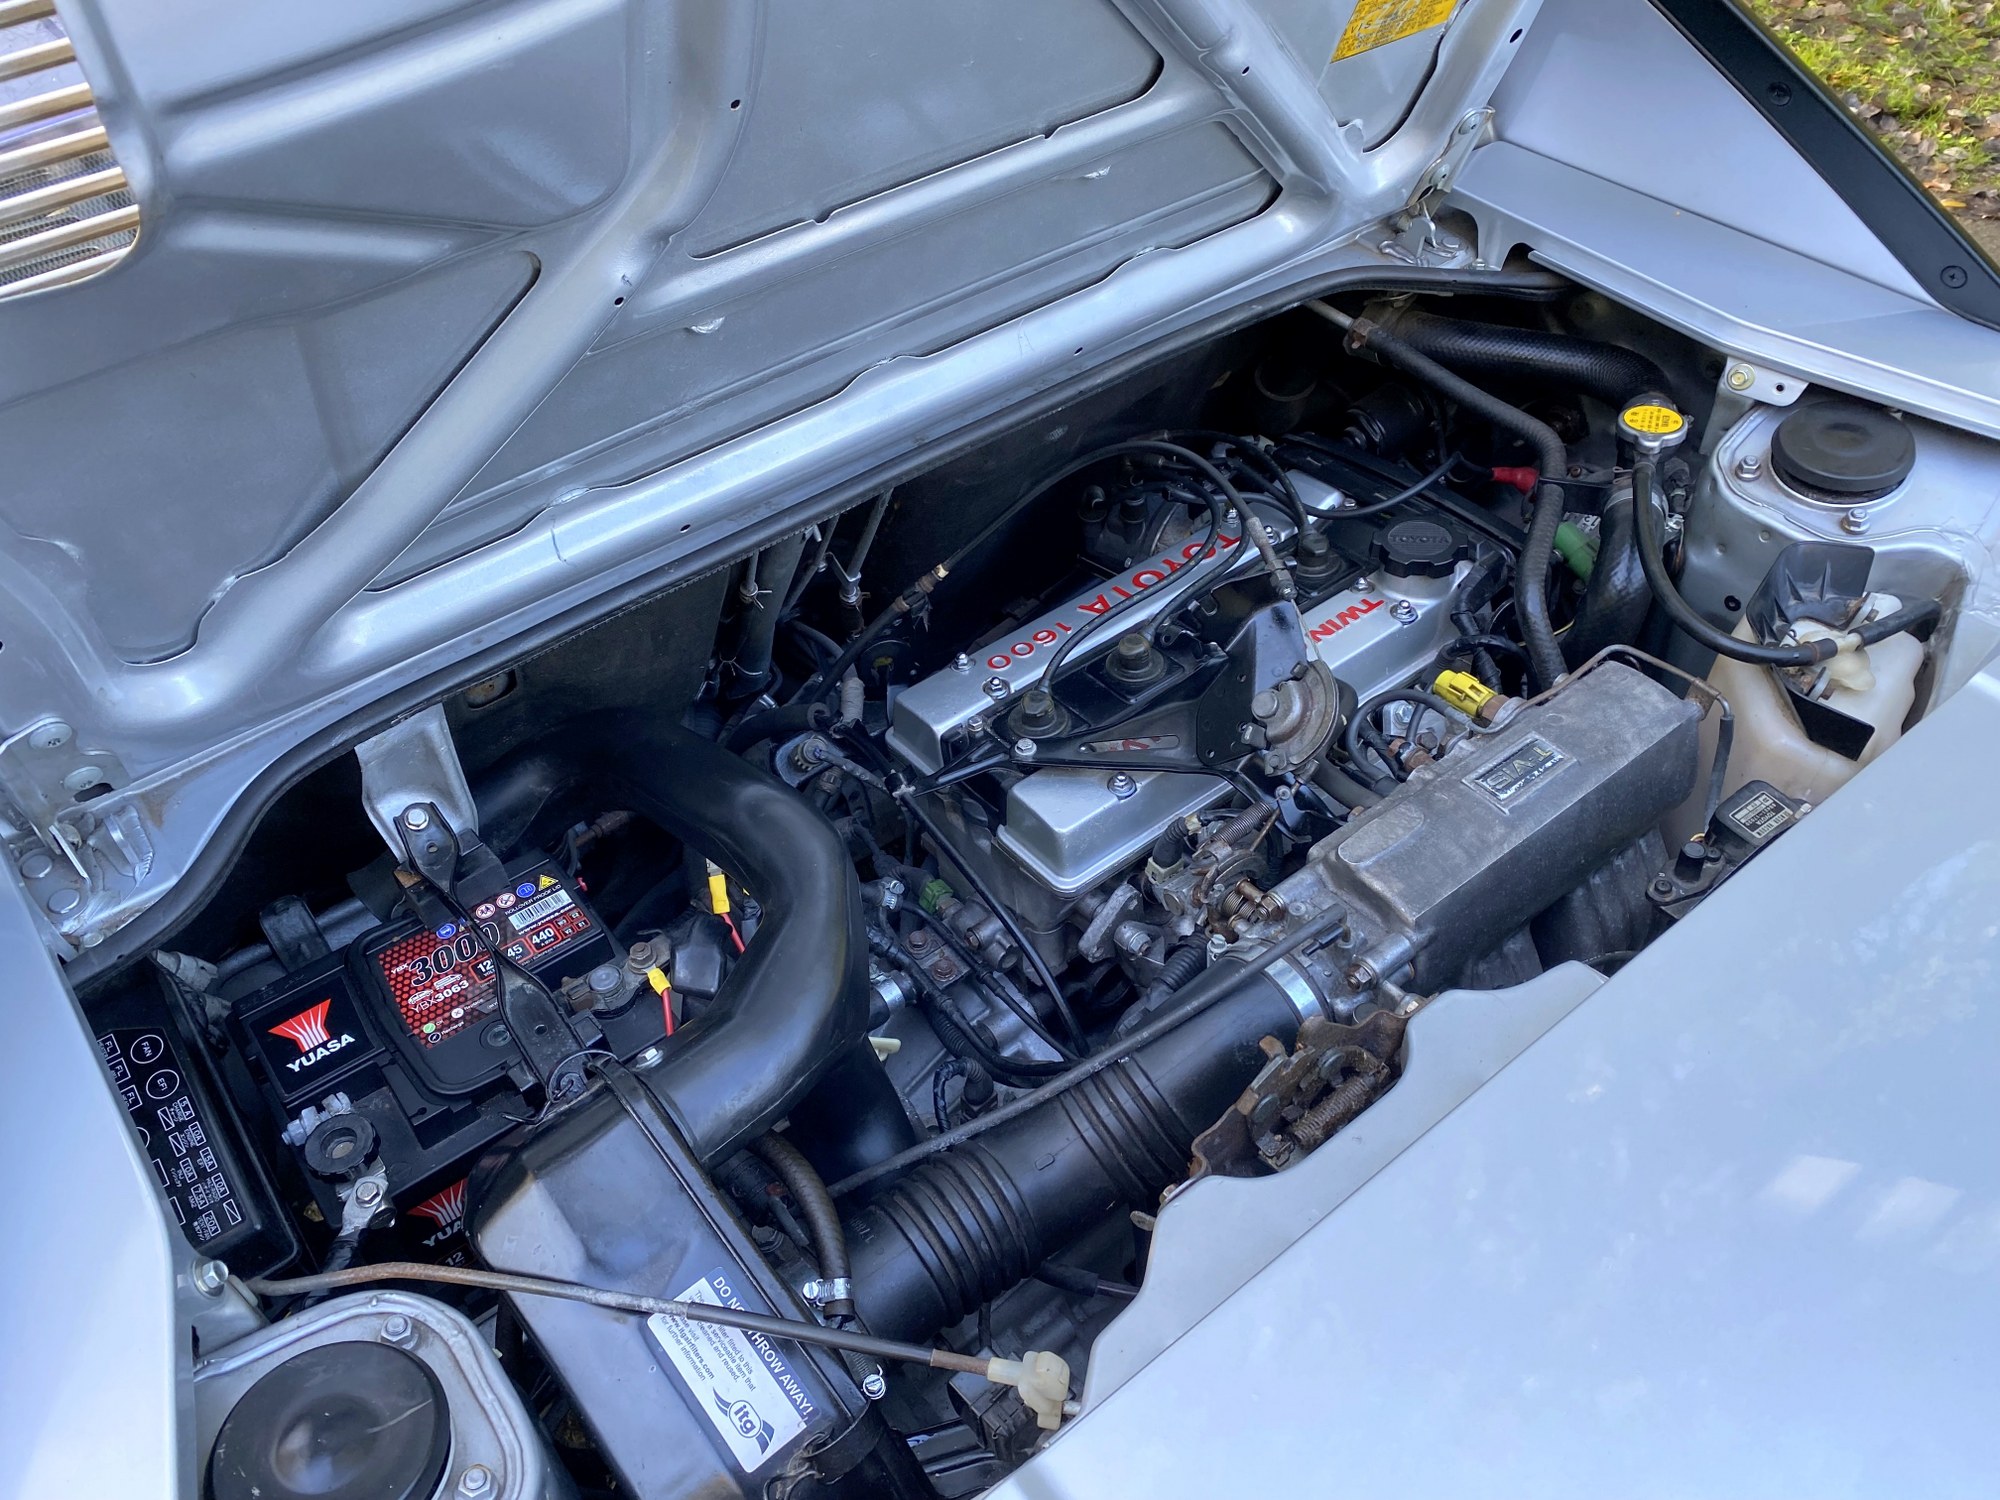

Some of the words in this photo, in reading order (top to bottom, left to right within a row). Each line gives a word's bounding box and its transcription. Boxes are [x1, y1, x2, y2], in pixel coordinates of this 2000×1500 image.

[1390, 535, 1449, 544] TOYOTA
[1077, 533, 1242, 617] TOYOTA
[1309, 598, 1385, 644] TWIN
[987, 622, 1072, 671] 1600
[1755, 811, 1776, 825] TOYOTA
[532, 928, 554, 944] 440
[408, 922, 500, 987] 3000
[507, 944, 523, 957] 45
[390, 962, 408, 974] YBX
[477, 958, 495, 972] 12
[411, 980, 469, 1013] YBX3063
[104, 1040, 114, 1052] FL
[140, 1040, 153, 1057] FAN
[286, 1033, 355, 1073] YUASA
[114, 1064, 124, 1076] FL
[156, 1077, 168, 1091] EFI
[125, 1091, 136, 1103] FL
[190, 1125, 203, 1142] 10A
[201, 1150, 214, 1167] 15A
[181, 1161, 194, 1178] 10A
[213, 1176, 226, 1193] 10A
[204, 1214, 217, 1232] 20A
[421, 1220, 469, 1247] YUA
[687, 1327, 700, 1341] visit
[697, 1321, 715, 1346] cleaned
[712, 1345, 725, 1359] and
[659, 1315, 669, 1326] for
[666, 1324, 683, 1346] further
[680, 1346, 706, 1381] information
[713, 1277, 731, 1297] DO
[779, 1374, 813, 1415] AWAY!
[710, 1328, 737, 1364] serviceable
[734, 1363, 747, 1378] item
[743, 1377, 756, 1391] that
[726, 1338, 741, 1355] fitted
[737, 1354, 746, 1362] to
[742, 1361, 754, 1374] this
[734, 1404, 756, 1434] itg
